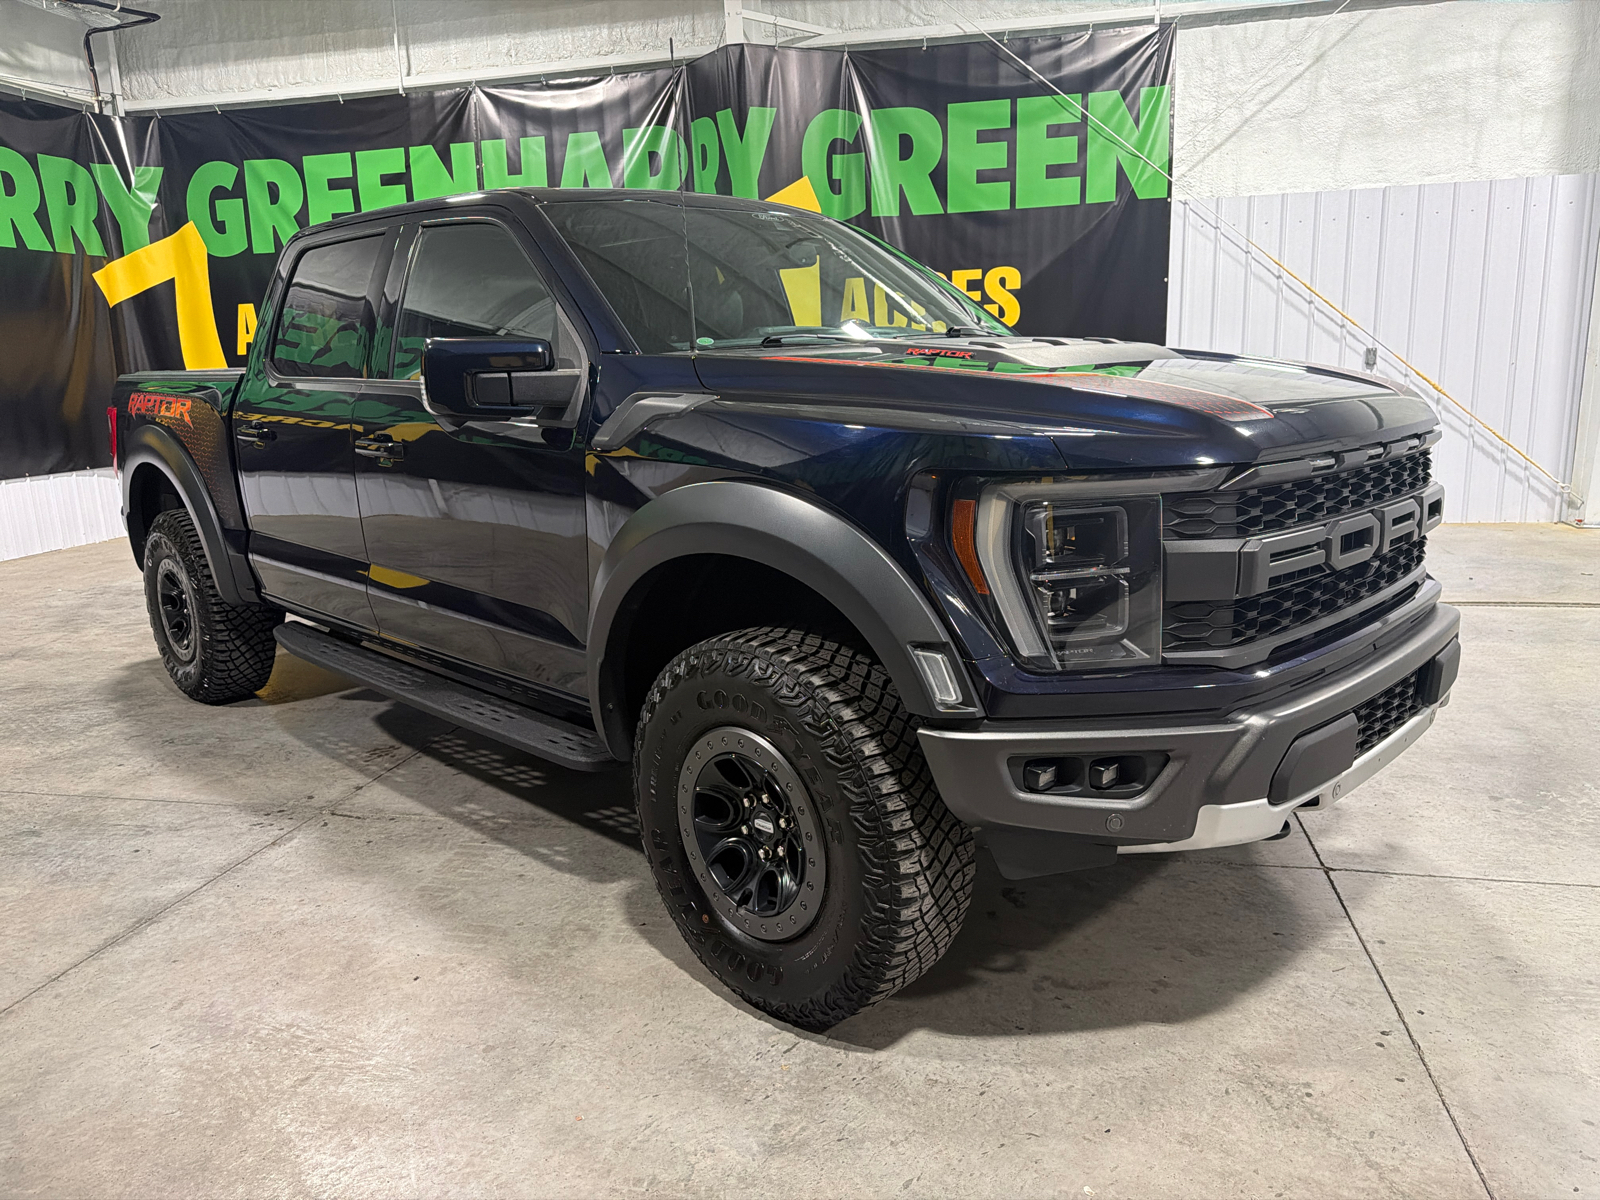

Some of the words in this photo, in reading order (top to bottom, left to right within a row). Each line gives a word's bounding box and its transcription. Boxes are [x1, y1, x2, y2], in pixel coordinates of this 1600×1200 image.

[187, 142, 478, 257] GREEN
[801, 85, 1171, 221] GREEN
[92, 221, 228, 370] 7
[906, 348, 974, 359] RAPTOR
[128, 393, 194, 430] RAPTOR
[1239, 480, 1445, 599] FORD
